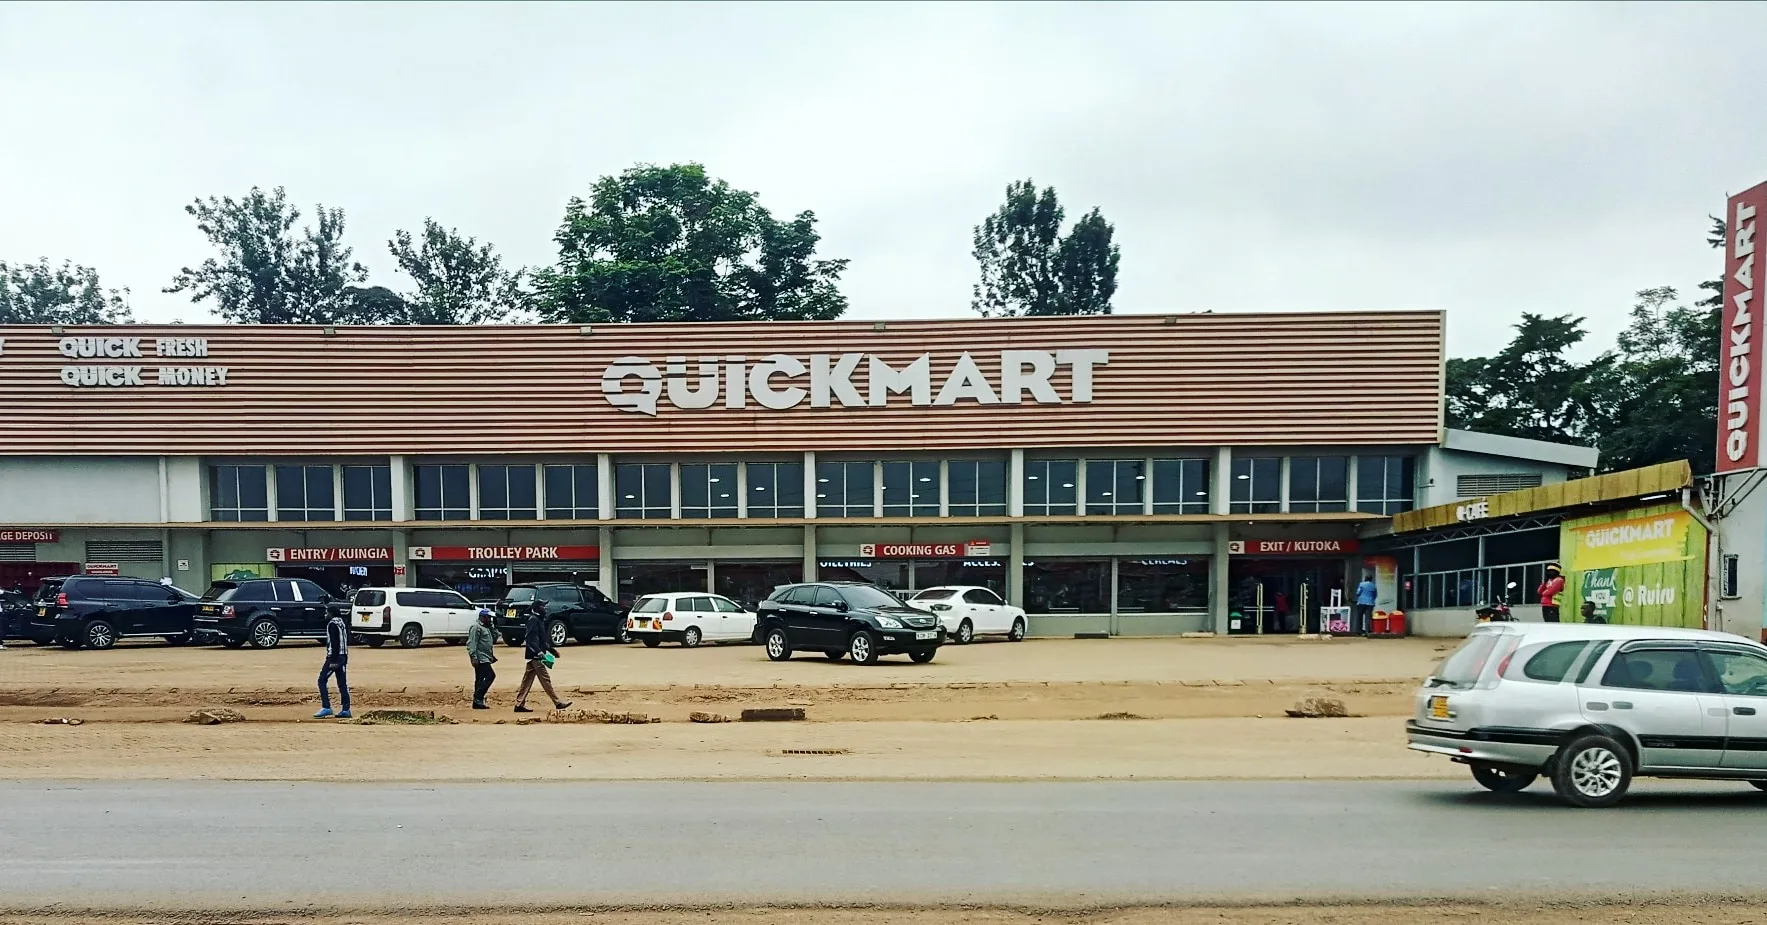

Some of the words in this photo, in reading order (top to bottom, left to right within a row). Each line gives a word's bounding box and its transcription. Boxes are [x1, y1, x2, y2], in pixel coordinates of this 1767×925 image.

[1726, 202, 1757, 462] QUICKMART
[58, 337, 143, 359] QUICK
[156, 338, 208, 357] FRESH
[60, 366, 144, 387] QUICK
[158, 367, 228, 386] MONEY
[602, 351, 1109, 417] QUICKMART
[0, 531, 13, 541] GE
[1586, 519, 1675, 548] QUICKMART
[290, 548, 328, 560] ENTRY
[330, 548, 335, 560] /
[338, 548, 389, 559] KUINGIA
[468, 547, 521, 559] TROLLEY
[525, 547, 558, 559] PARK
[883, 545, 932, 556] COOKING
[934, 545, 956, 555] GAS
[1260, 541, 1285, 552] EXIT
[1294, 541, 1340, 551] KUTOKA
[1584, 568, 1617, 591] Thank
[1622, 587, 1634, 607] @
[1637, 583, 1675, 606] Ruiru
